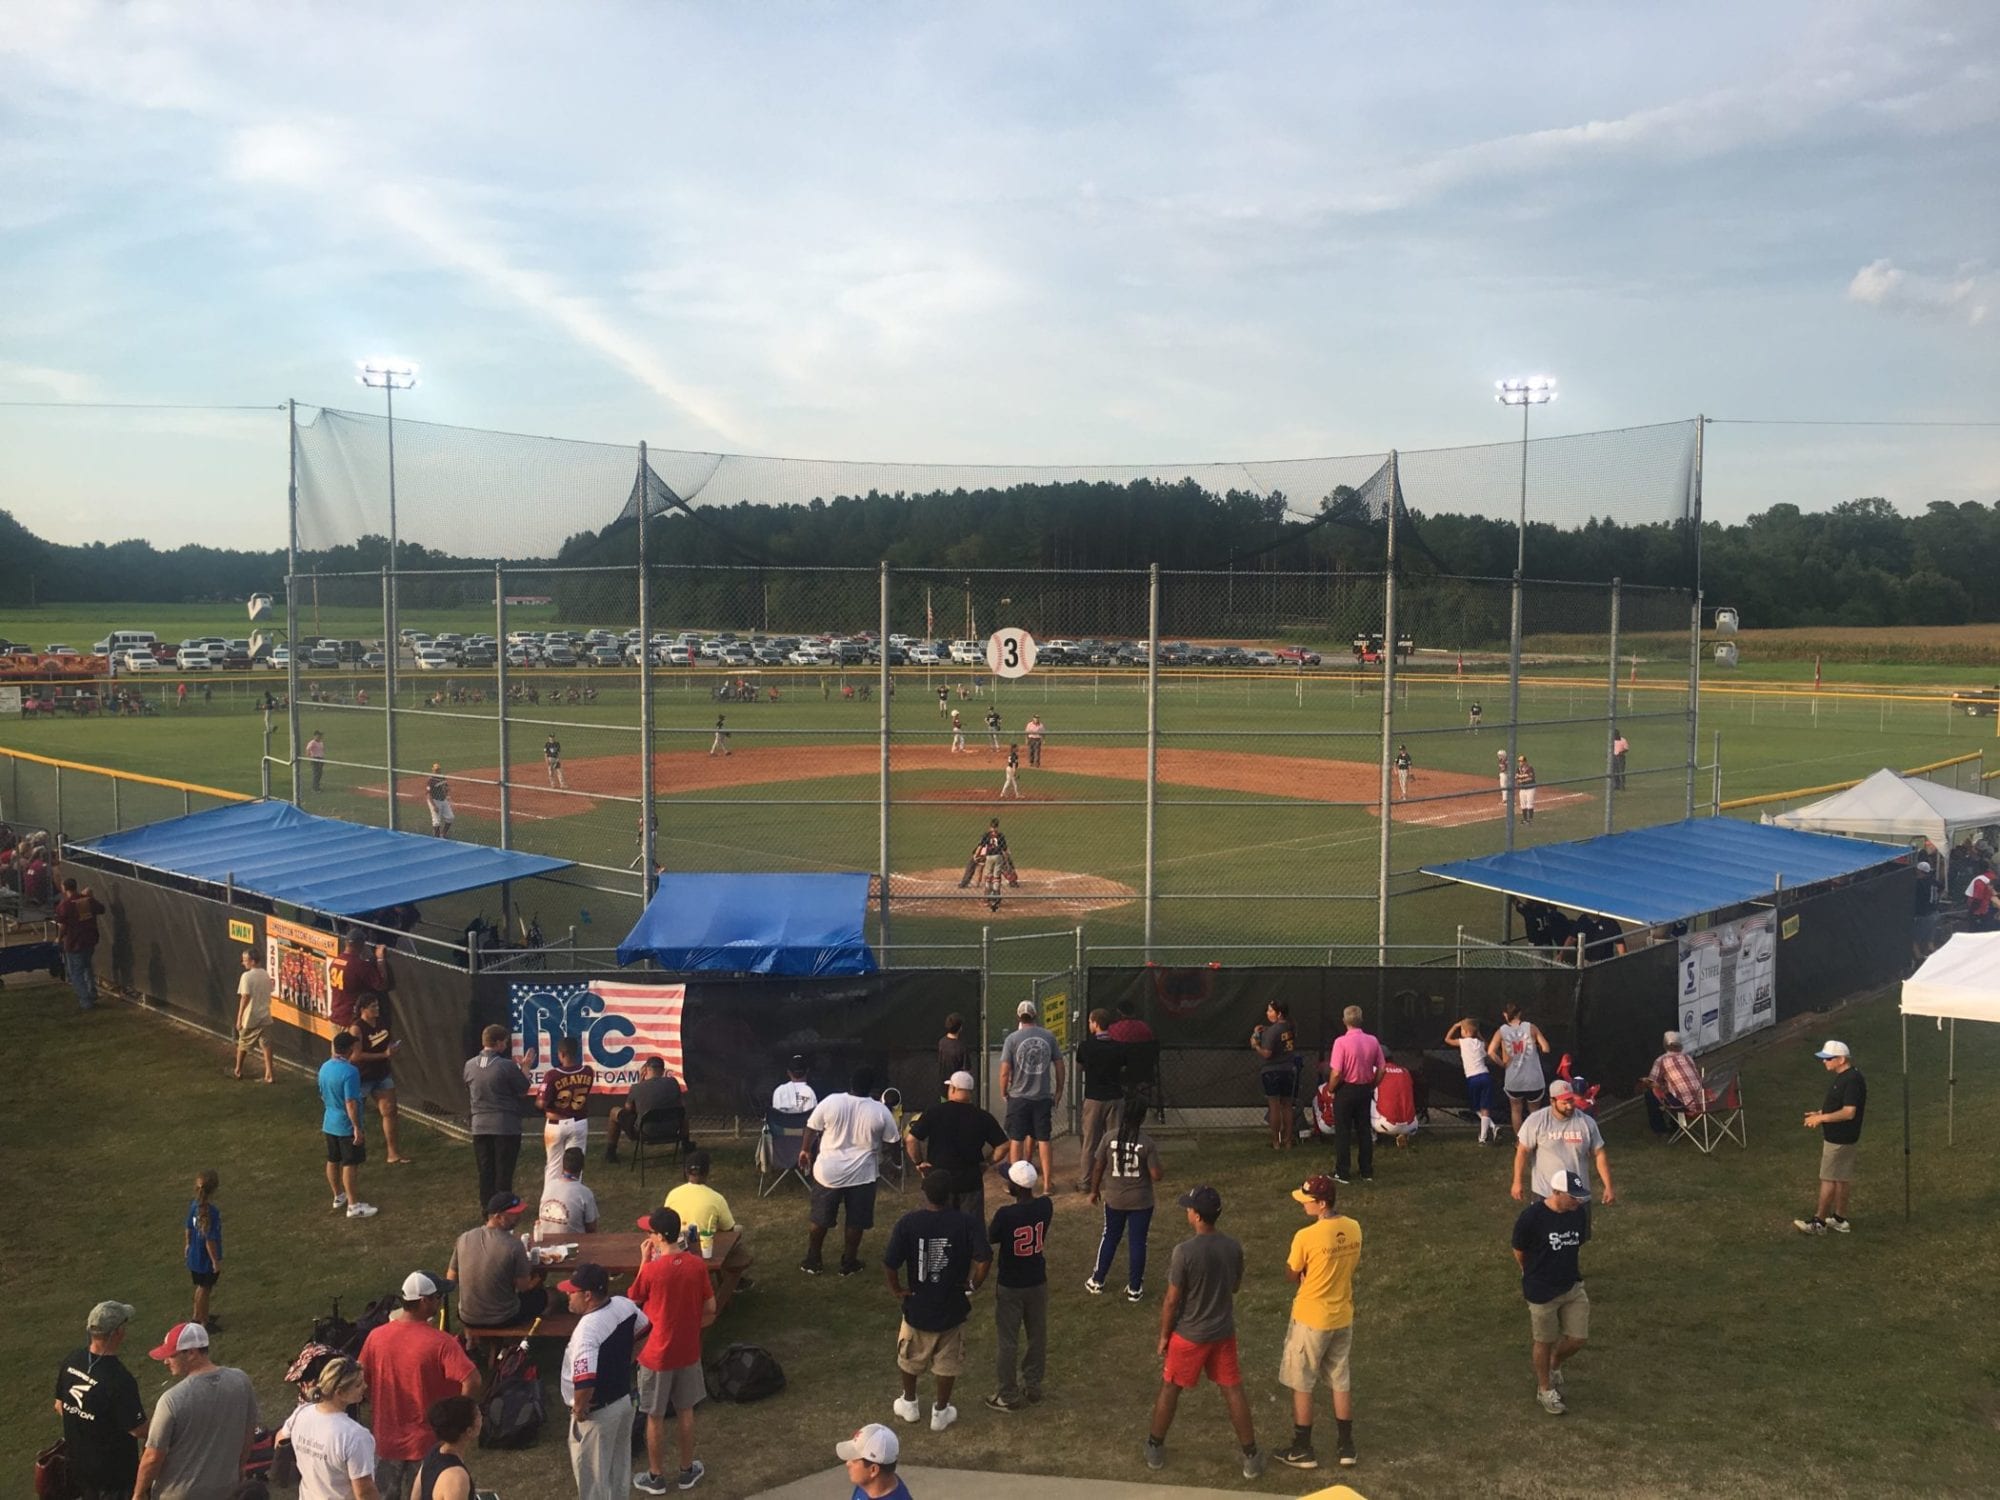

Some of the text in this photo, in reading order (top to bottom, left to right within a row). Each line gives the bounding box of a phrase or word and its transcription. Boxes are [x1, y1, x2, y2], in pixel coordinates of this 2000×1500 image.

[1004, 638, 1019, 668] 3
[231, 921, 252, 940] AWAY
[330, 967, 344, 991] 34
[1512, 1041, 1524, 1054] M
[596, 1071, 640, 1083] FOAM
[556, 1089, 588, 1111] 35
[1013, 1221, 1044, 1257] 21
